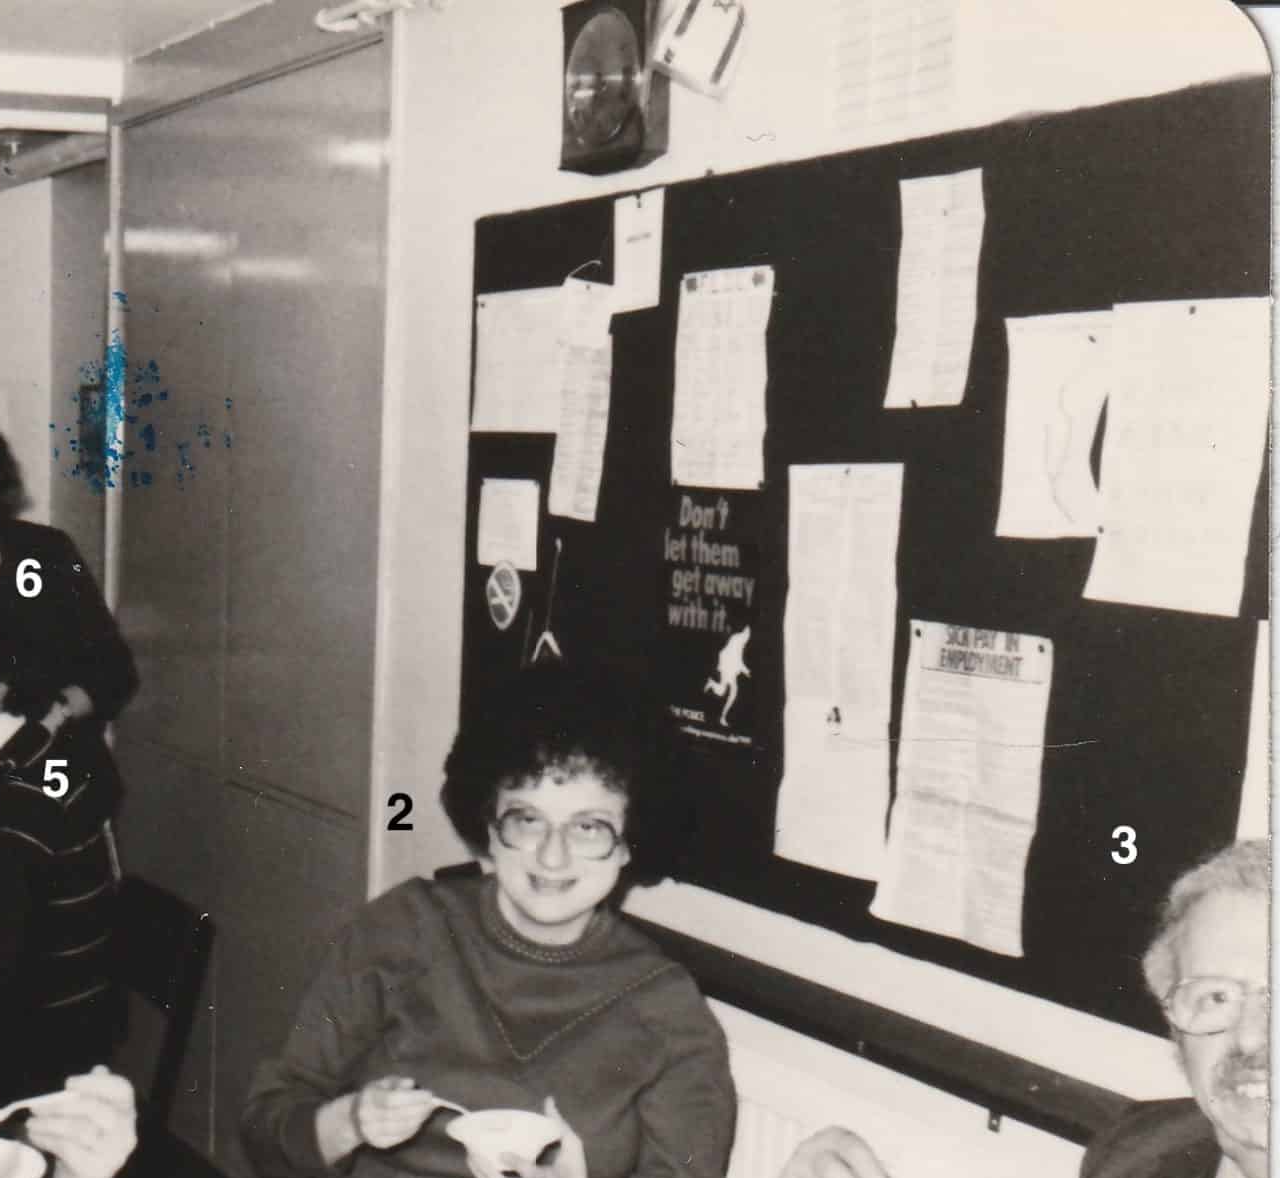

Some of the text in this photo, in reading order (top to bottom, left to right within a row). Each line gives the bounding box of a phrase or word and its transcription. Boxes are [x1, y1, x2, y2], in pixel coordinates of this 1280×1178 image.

[679, 495, 728, 530] Don't
[664, 527, 739, 567] let them
[672, 566, 756, 608] get away
[667, 597, 708, 629] with
[939, 647, 1024, 677] EMPLOYMENT
